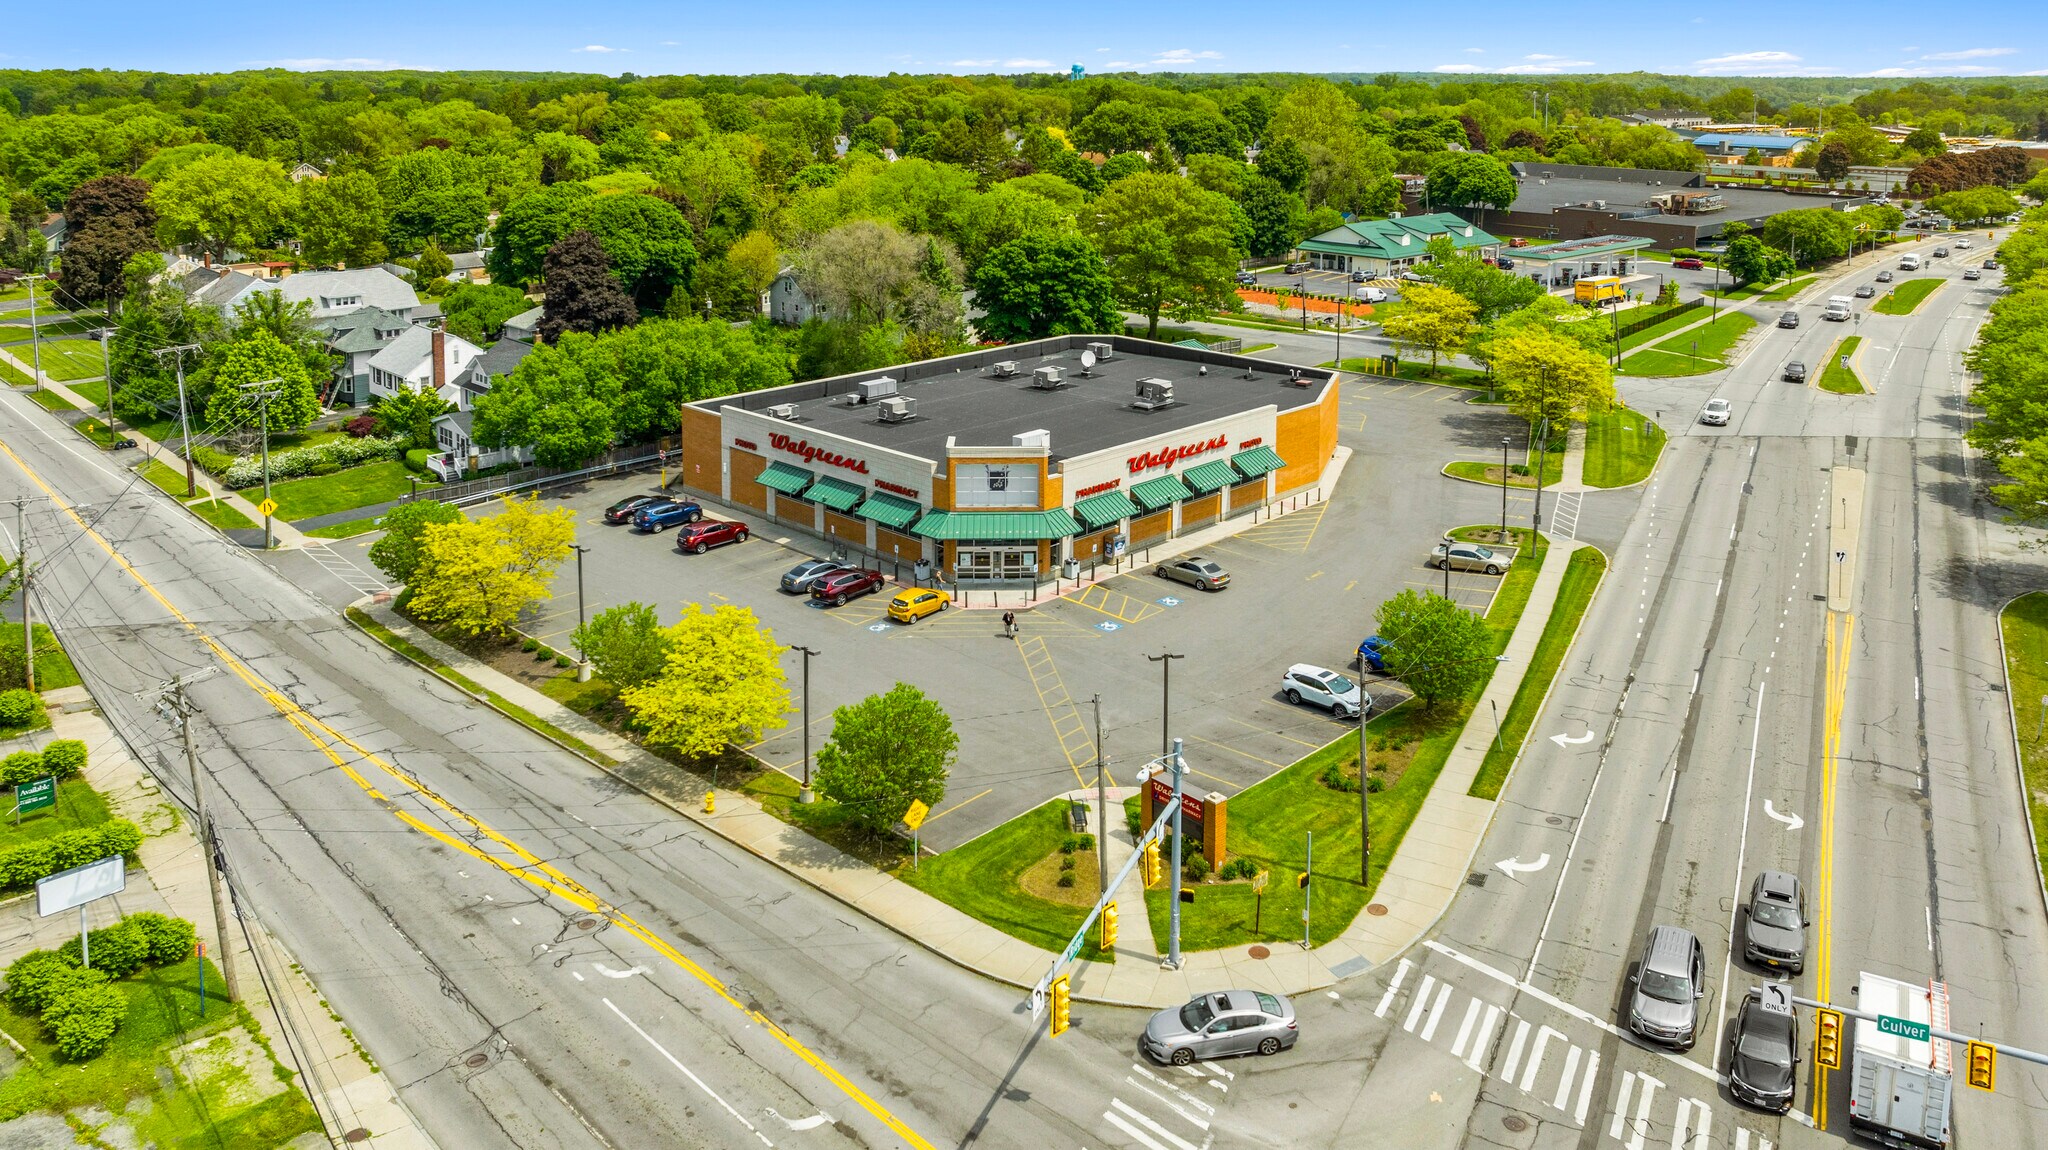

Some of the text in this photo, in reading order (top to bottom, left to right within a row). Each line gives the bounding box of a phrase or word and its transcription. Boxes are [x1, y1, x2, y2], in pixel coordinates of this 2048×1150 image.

[1239, 437, 1262, 449] PHOTO
[768, 432, 869, 474] Walgreens
[1126, 433, 1228, 473] Walgreens
[874, 479, 919, 498] PHARMACY
[1076, 478, 1121, 498] PHARMACY
[20, 783, 50, 796] Available
[1765, 1002, 1788, 1012] ONLY
[1880, 1018, 1926, 1038] Culver
